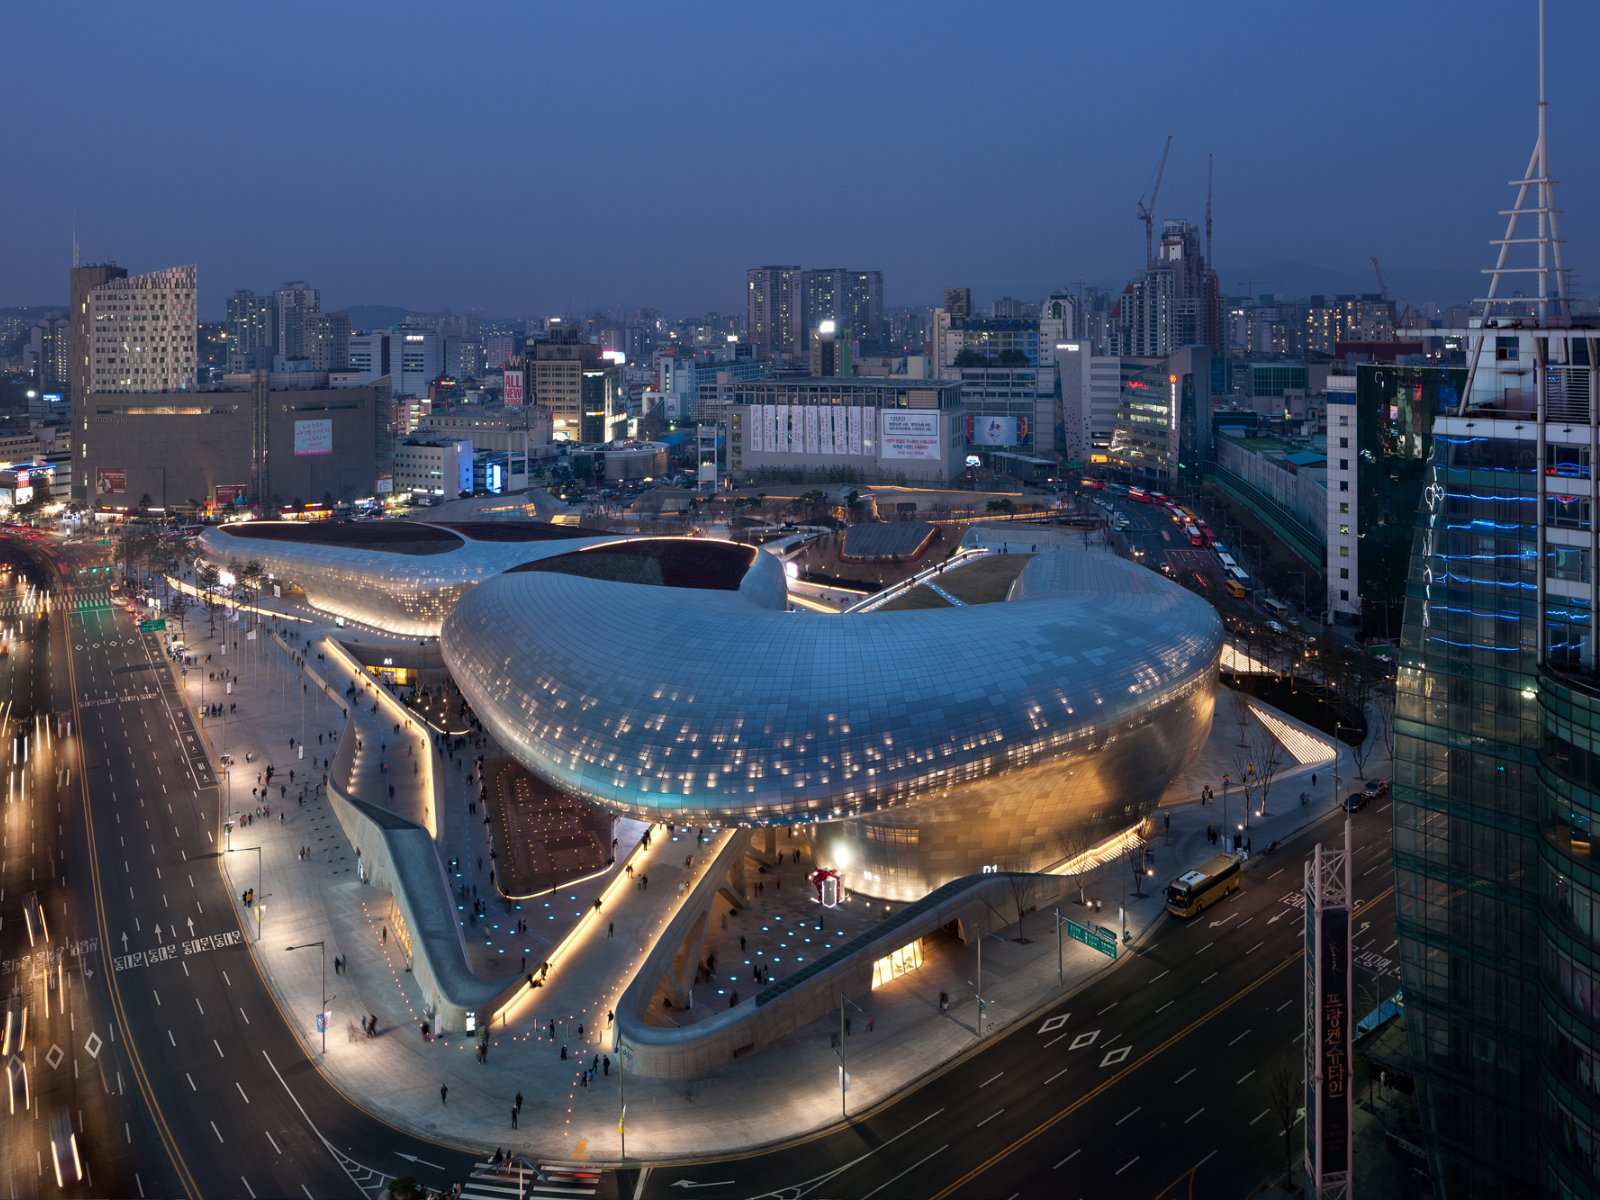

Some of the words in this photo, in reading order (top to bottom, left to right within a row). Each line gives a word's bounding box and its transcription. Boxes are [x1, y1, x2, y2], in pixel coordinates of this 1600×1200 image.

[505, 375, 522, 388] ALL
[505, 388, 522, 398] NEW
[95, 415, 128, 427] maxtyle
[114, 951, 143, 971] 동대문
[148, 944, 177, 963] 동대문
[182, 936, 210, 955] 동대문
[213, 929, 243, 949] 동대문
[1324, 992, 1345, 1099] 프랑켄슈타인
[622, 1048, 633, 1061] ddp
